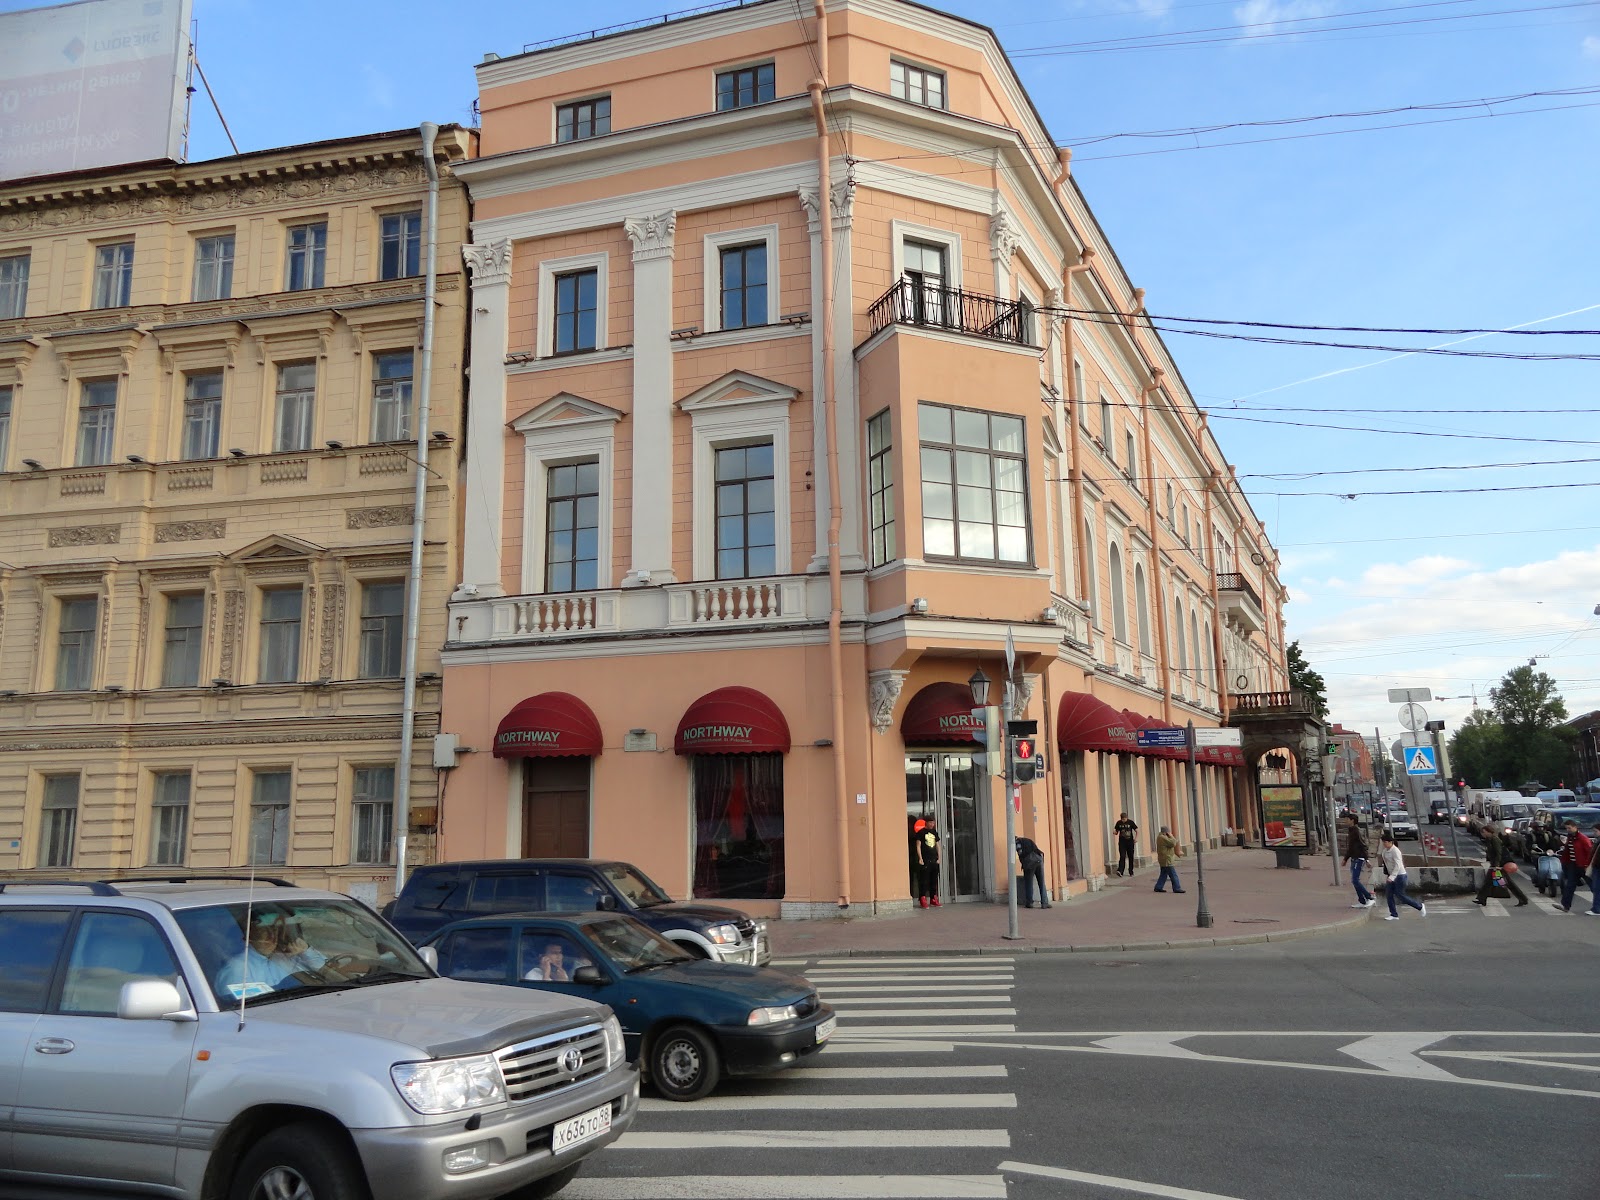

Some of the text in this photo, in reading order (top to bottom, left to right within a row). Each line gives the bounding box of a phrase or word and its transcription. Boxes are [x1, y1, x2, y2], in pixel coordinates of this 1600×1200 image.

[939, 715, 984, 727] NORTH
[498, 731, 560, 744] NORTHWAY
[683, 726, 752, 740] NORTHWAY
